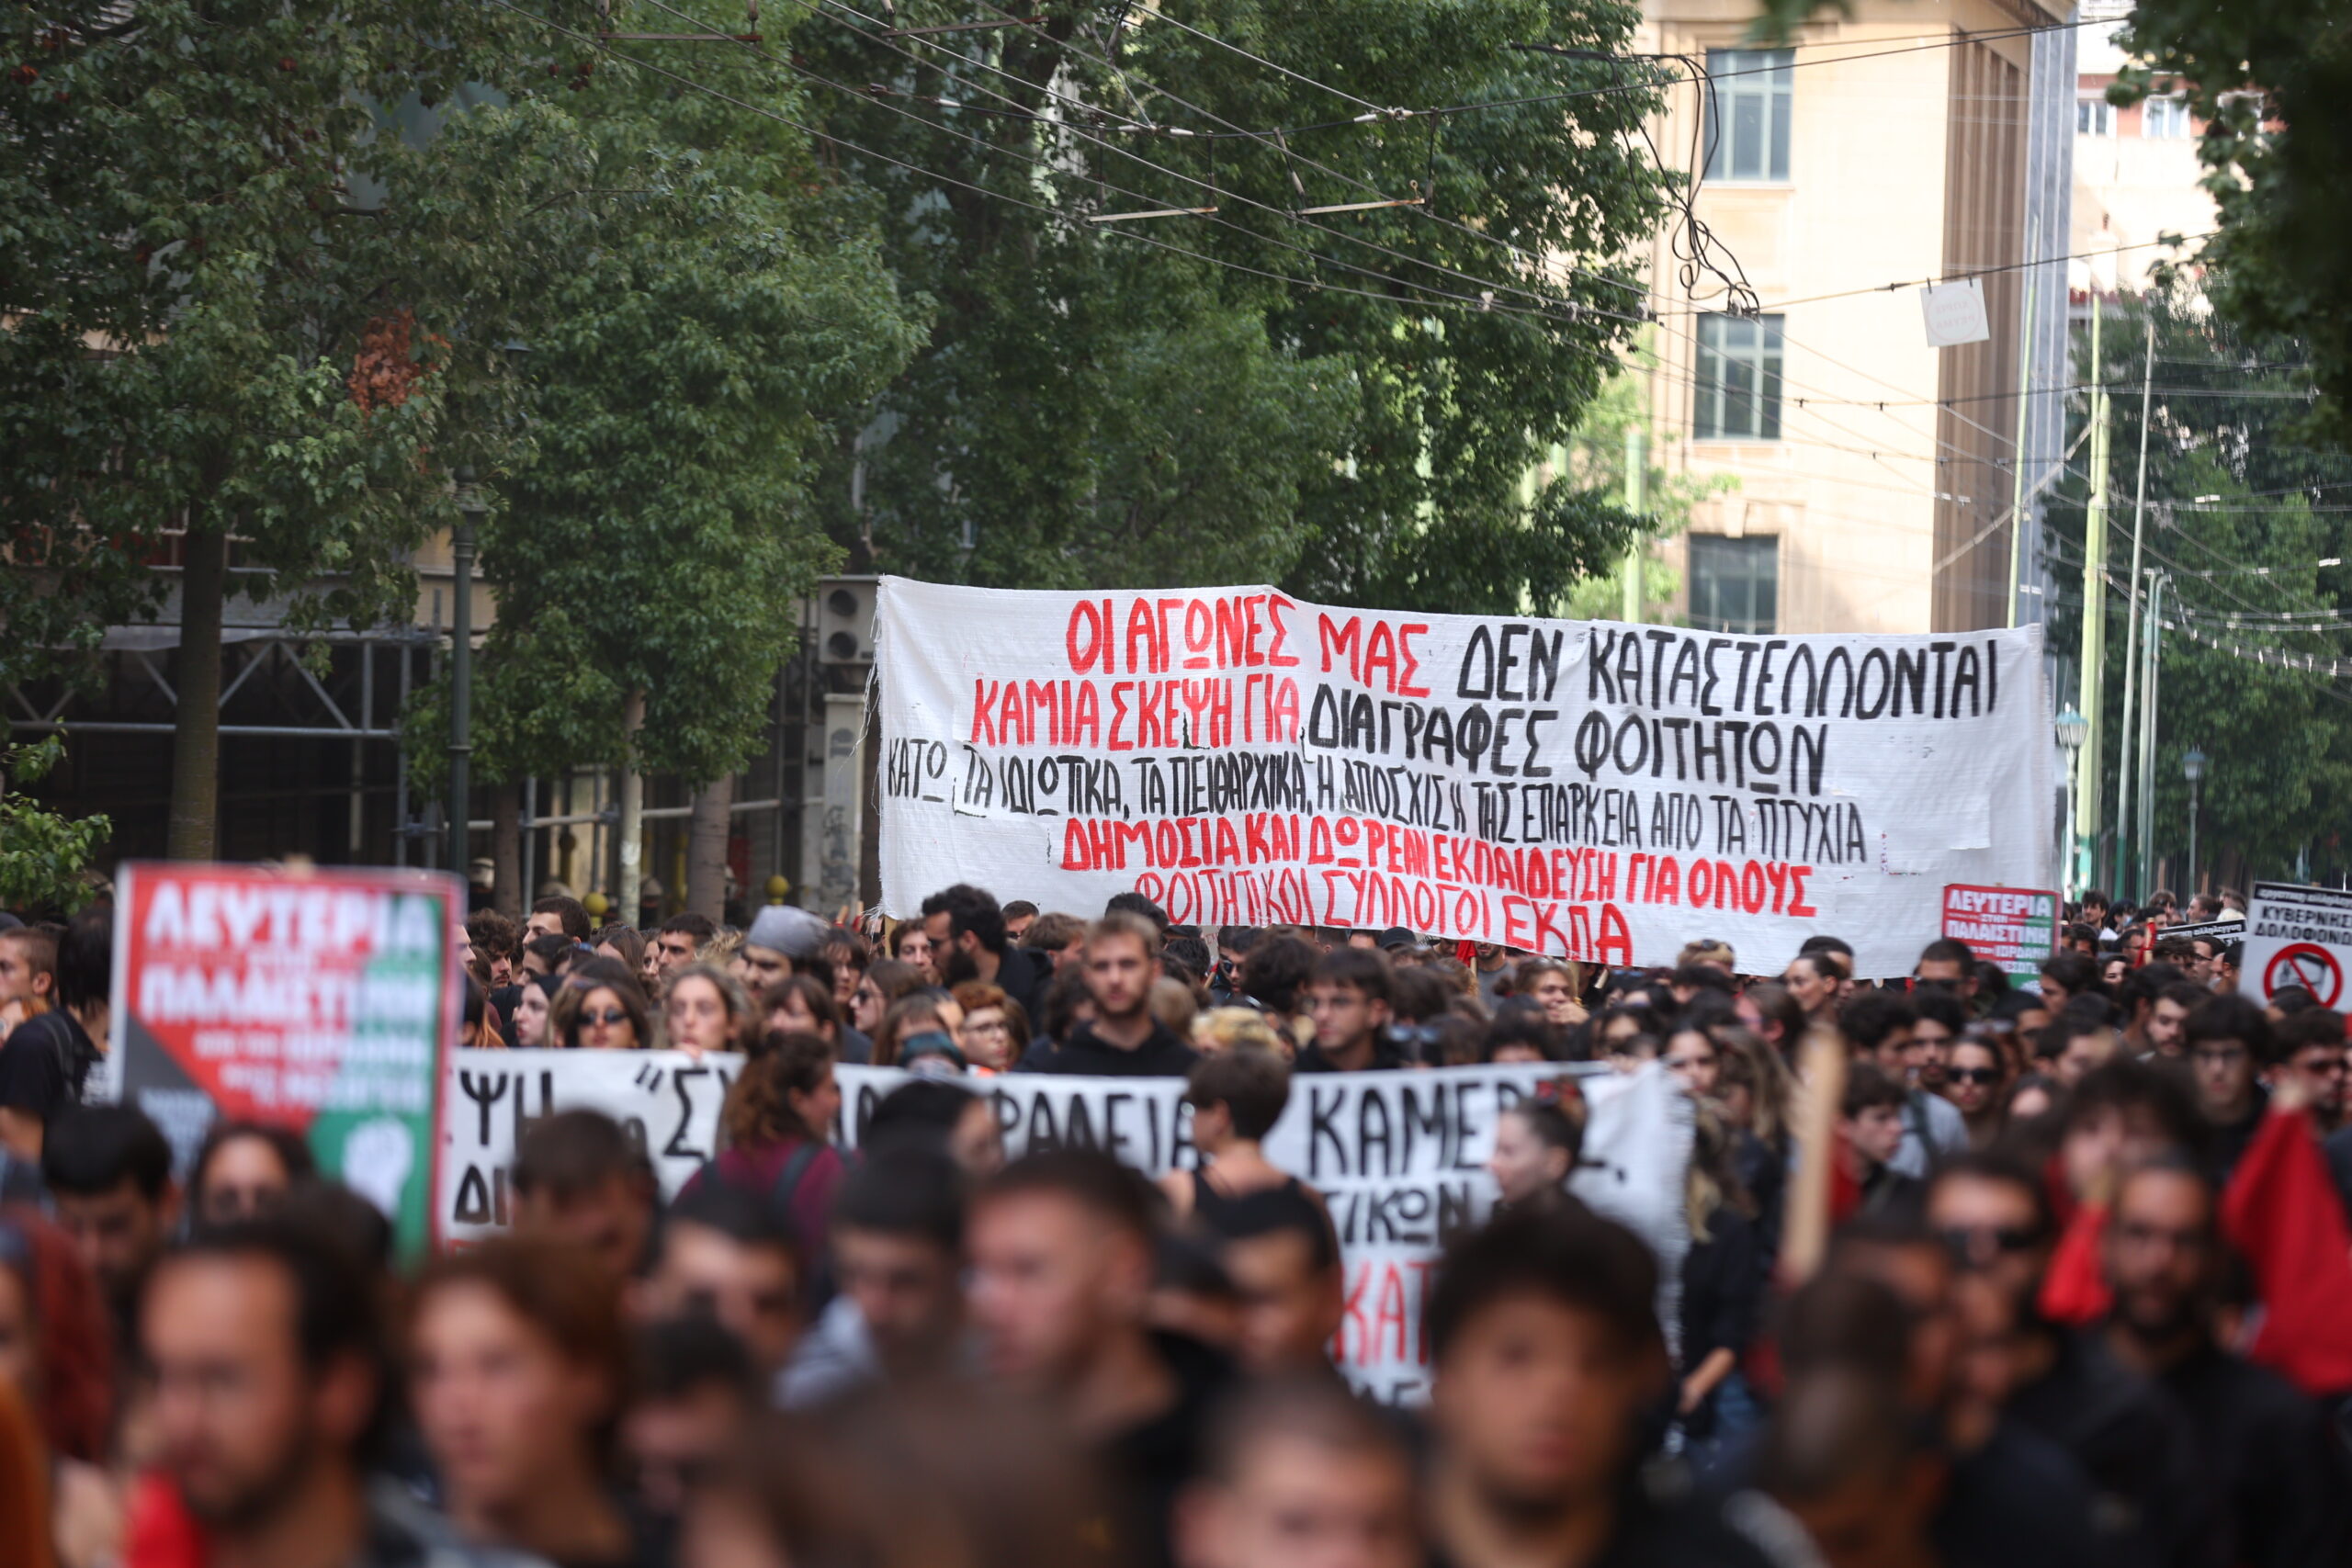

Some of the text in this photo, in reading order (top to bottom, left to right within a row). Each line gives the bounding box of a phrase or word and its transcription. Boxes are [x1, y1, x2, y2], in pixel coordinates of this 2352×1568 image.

[1066, 593, 1998, 720] ΟΙ ΑΓΩΝΕΣ ΜΑΣ ΔΕΝ ΚΑΤΑΣΤΕΛΛΟΝΤΑΙ
[971, 672, 1827, 796] ΚΑΜΙΑ ΣΚΕΨΗ ΓΙΑ ΔΙΑΓΡΑΦΕΣ ΦΟΙΤΗΤΩΝ
[888, 737, 947, 803] ΚΑΤΩ
[963, 744, 993, 809] ΤΑ
[1131, 757, 1166, 816] ΤΑ
[1317, 754, 1335, 813] Η
[1471, 781, 1517, 843] ΤΗΣ
[1521, 782, 1642, 850] ΕΠΑΡΚΕΙΑ
[1650, 791, 1703, 851] ΑΠΟ
[1709, 795, 1746, 855] ΤΑ
[1754, 798, 1867, 864] ΠΤΥΧΙΑ
[1059, 817, 1241, 872] ΔΗΜΟΣΙΑ
[1245, 812, 1301, 864] ΚΑΙ
[1432, 833, 1618, 902] ΕΚΠΑΙΔΕΥΣΗ
[1625, 852, 1680, 905] ΓΙΑ
[1688, 858, 1817, 918] ΟΛΟΥΣ
[1321, 869, 1491, 939] ΣΥΛΛΟΓΟΙ
[1501, 895, 1634, 965] ΕΚΠΑ
[1947, 888, 2052, 918] ΛΕΥΤΕΡΙΑ
[1945, 919, 2051, 944] ΠΑΛΑΙΣΤΙΝΗ
